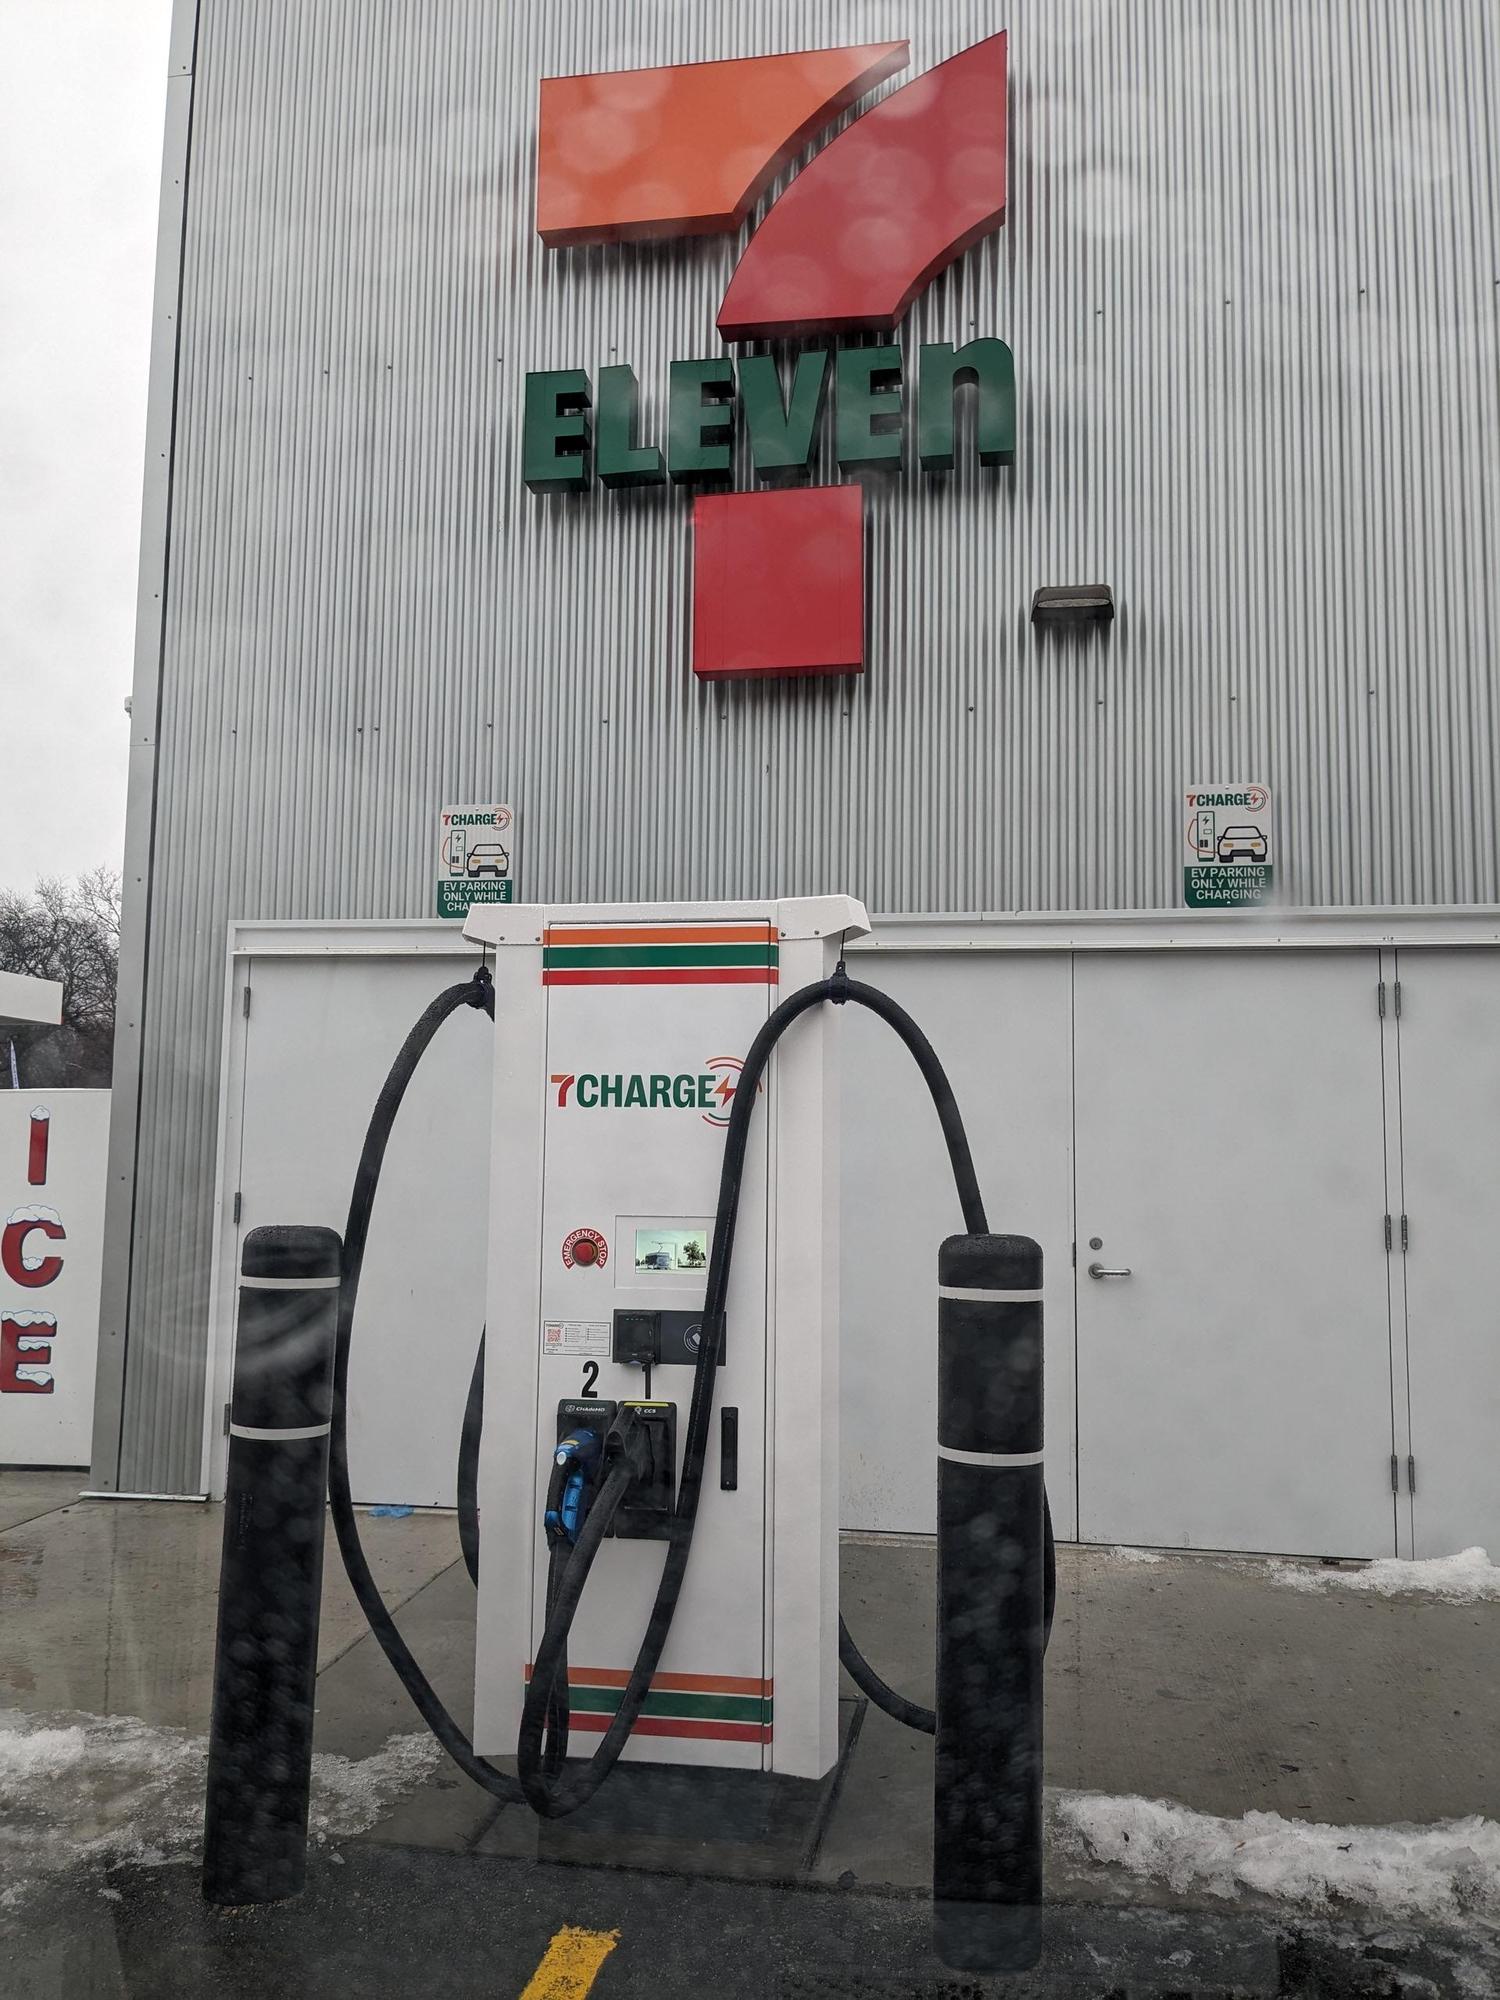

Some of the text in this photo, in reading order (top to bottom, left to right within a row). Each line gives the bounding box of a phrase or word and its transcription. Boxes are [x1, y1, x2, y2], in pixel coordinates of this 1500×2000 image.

[1186, 793, 1251, 807] 7CHARGE
[442, 813, 497, 826] 7CHARGE
[1191, 866, 1265, 878] EV PARKING
[443, 881, 506, 891] EV PARKING
[1191, 877, 1267, 889] ONLY WHILE
[443, 891, 507, 901] ONLY WHILE
[1196, 888, 1262, 900] CHARGING
[551, 1073, 717, 1109] 7CHARGE
[0, 1105, 66, 1394] ICE
[563, 1229, 607, 1266] EMERGENCY STOP
[581, 1360, 599, 1398] 2
[642, 1363, 652, 1400] 1
